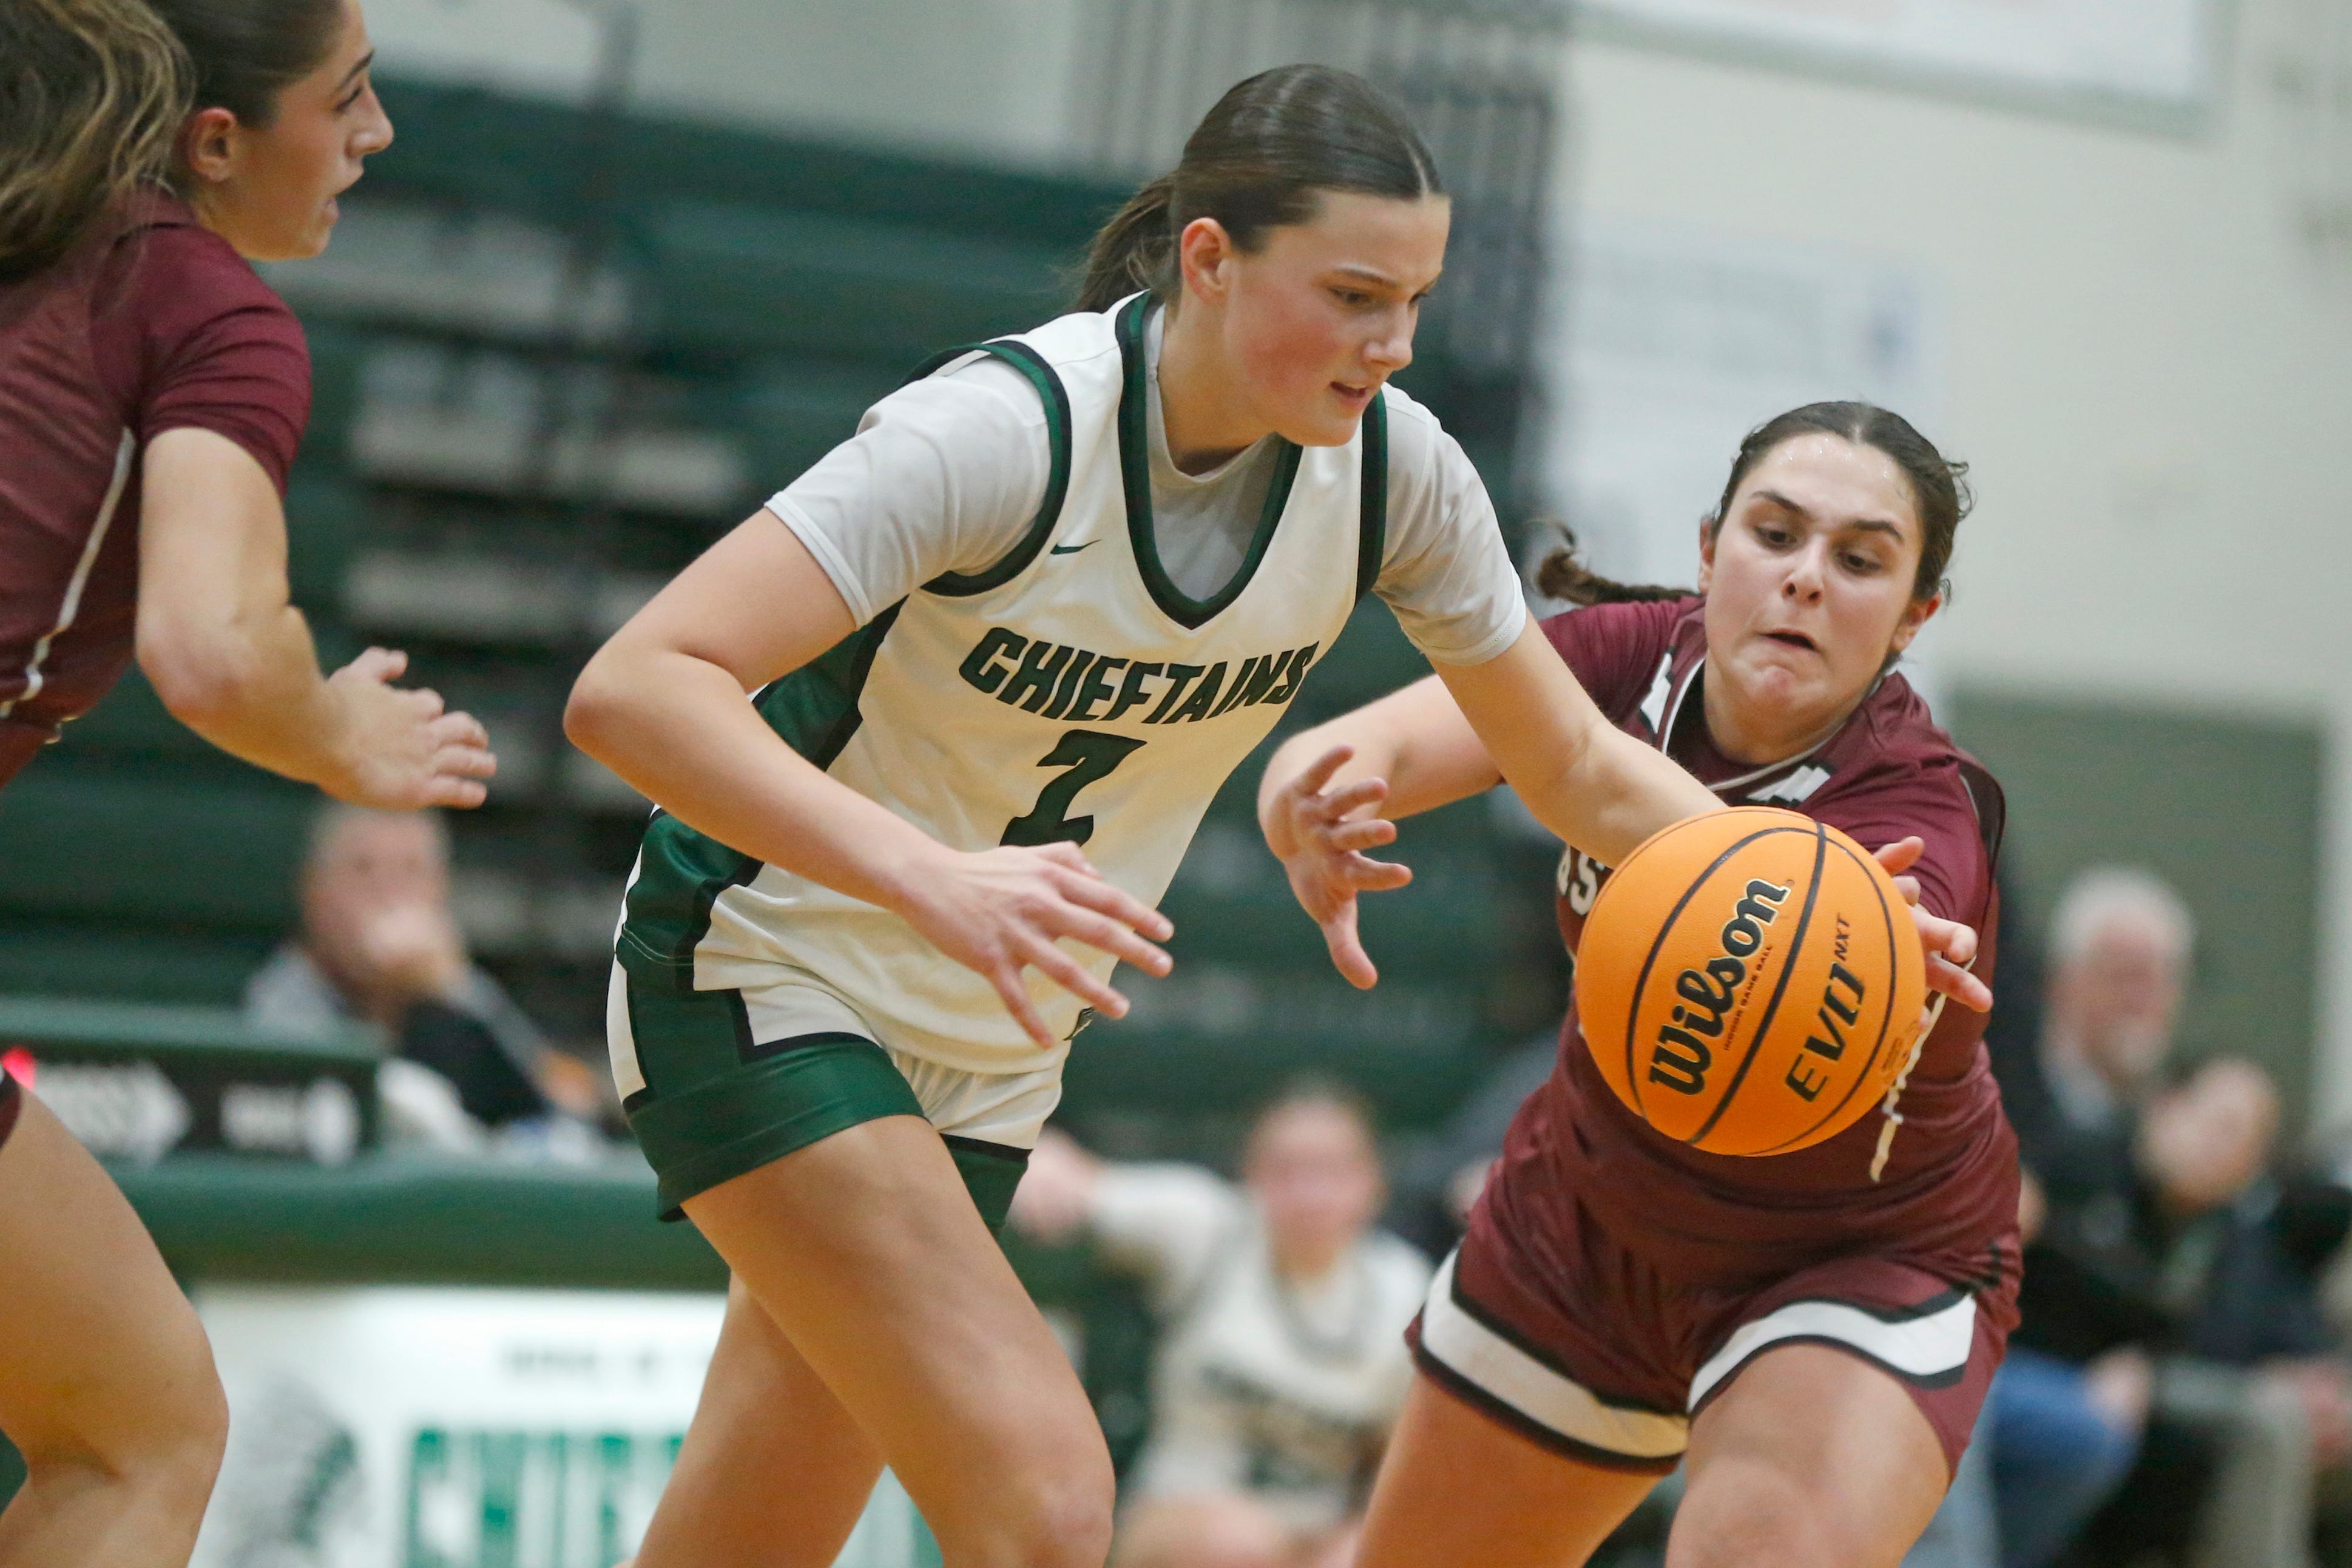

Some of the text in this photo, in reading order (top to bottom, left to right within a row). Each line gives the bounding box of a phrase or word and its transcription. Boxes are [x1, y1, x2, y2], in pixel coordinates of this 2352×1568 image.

[959, 627, 1320, 725] CHIEFTAINS
[1740, 975, 1759, 1007] GAME
[1756, 944, 1773, 972] BALL
[1834, 912, 1851, 961] NXT
[1649, 878, 1791, 1095] Wilson
